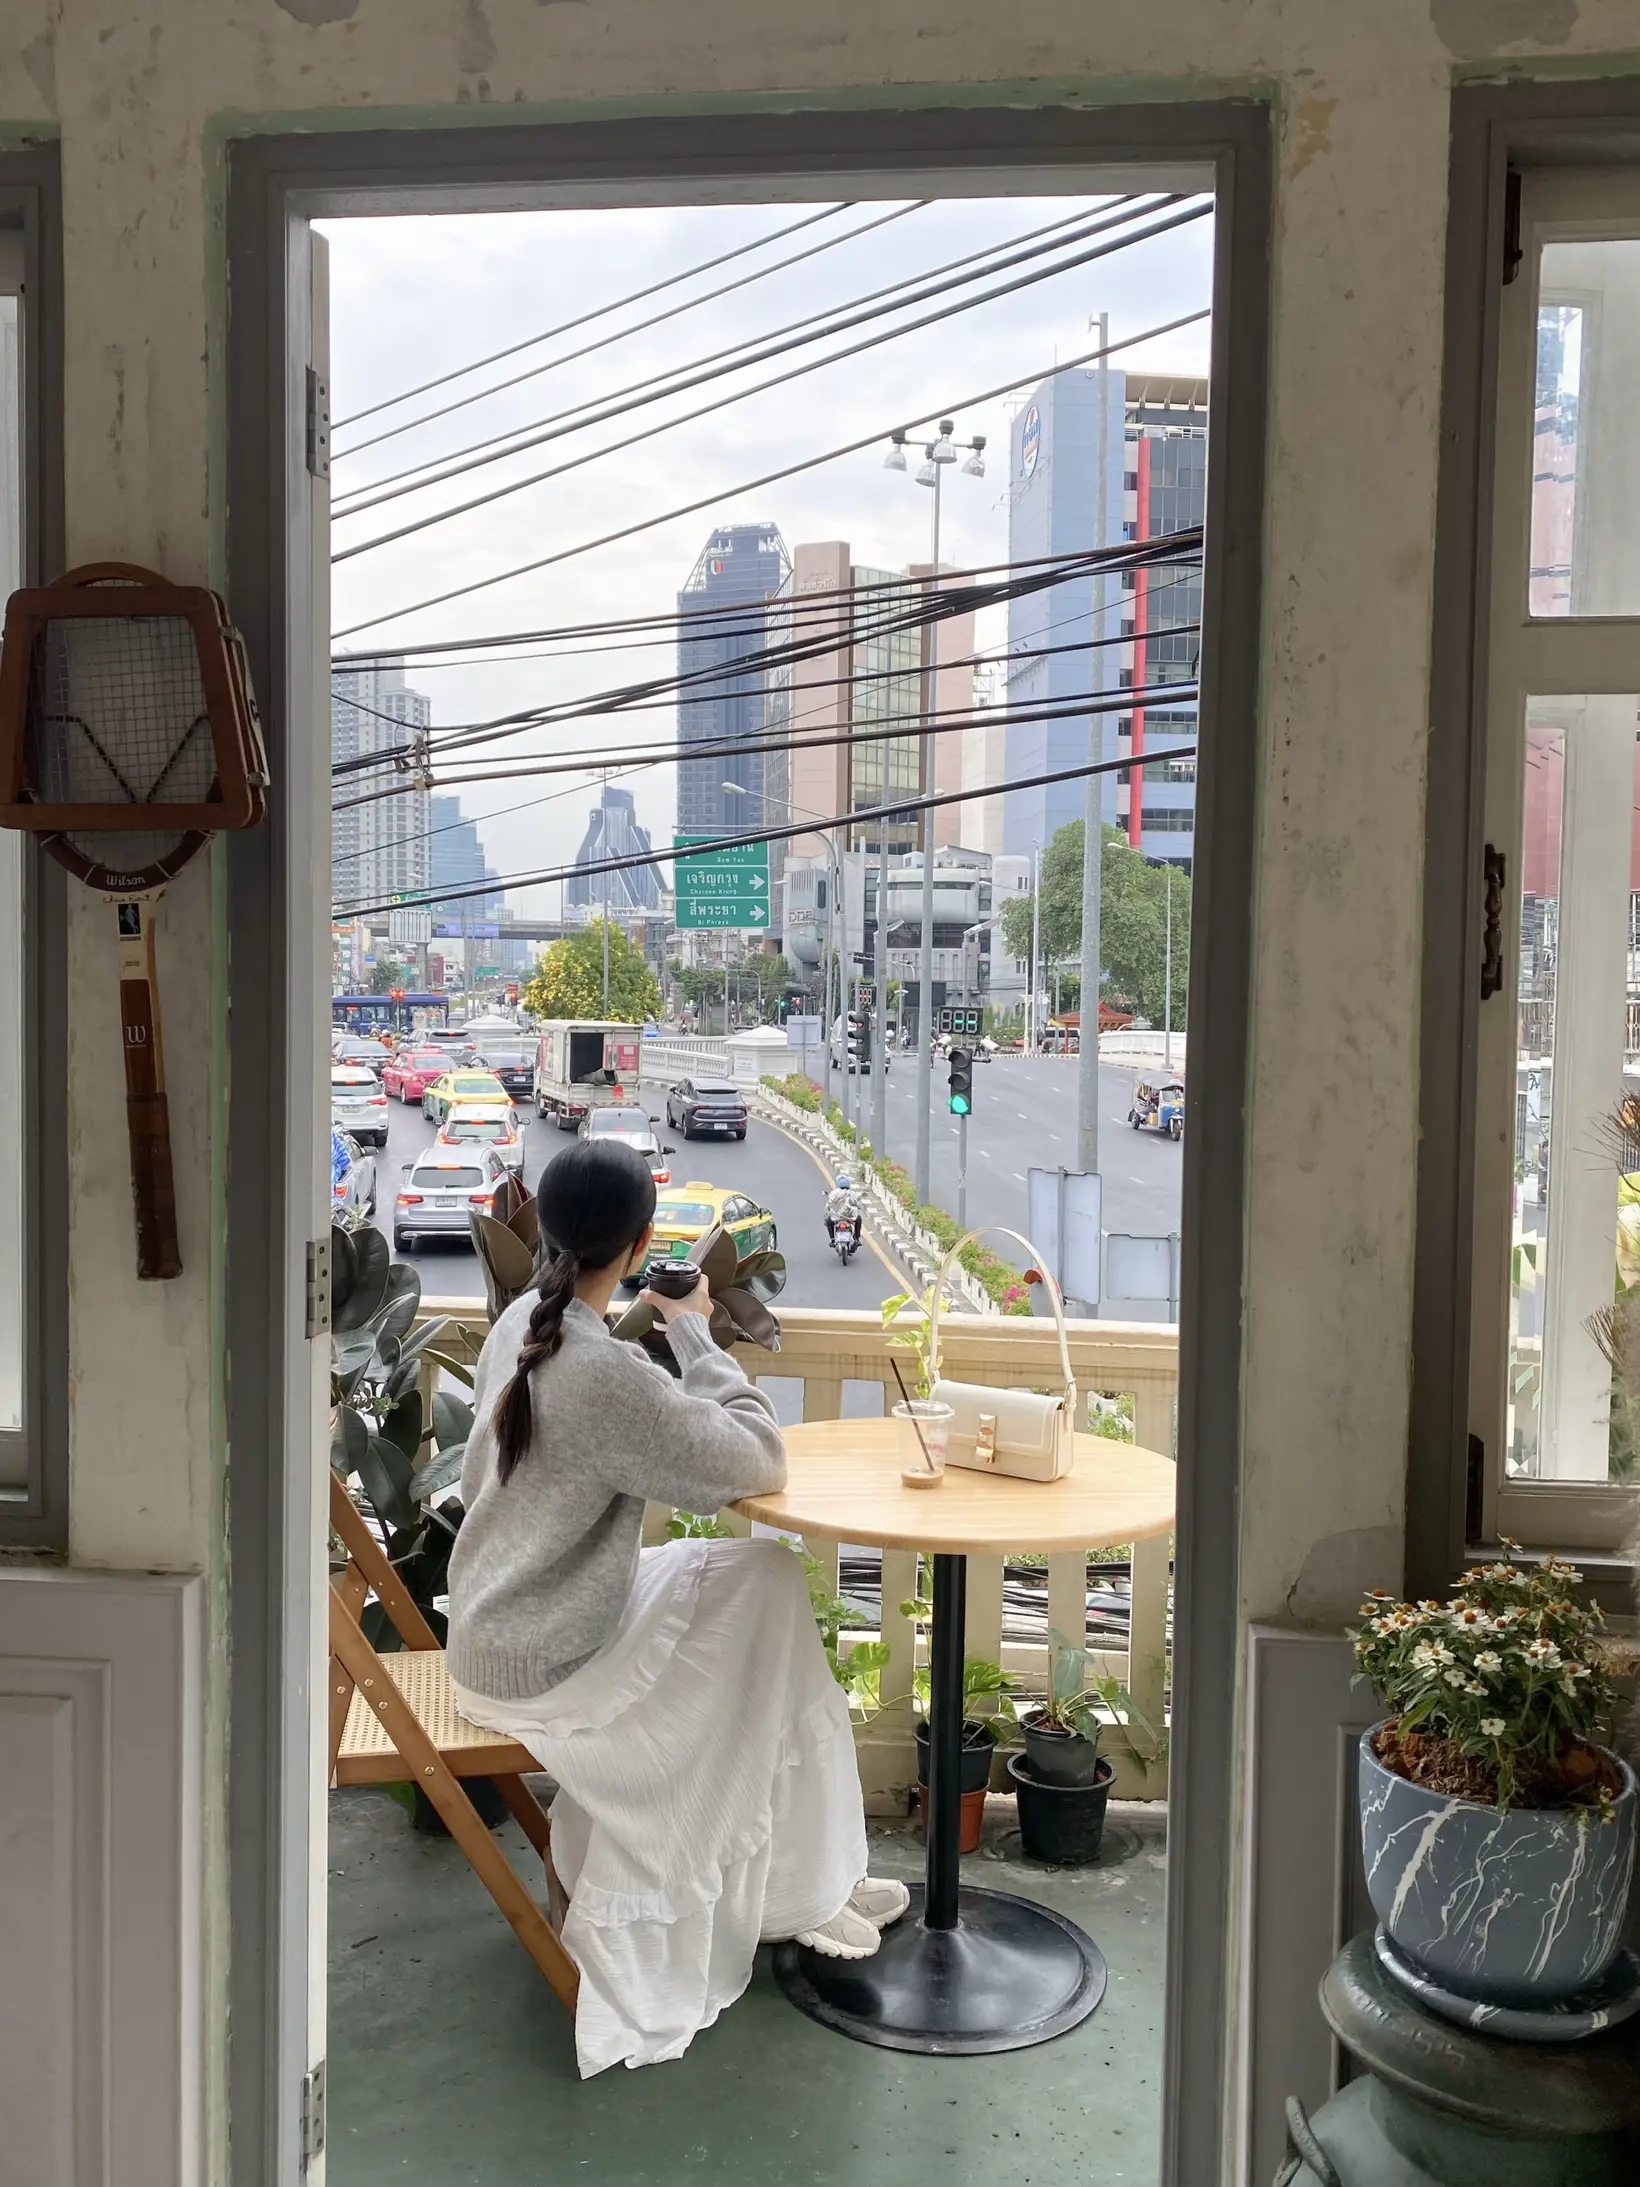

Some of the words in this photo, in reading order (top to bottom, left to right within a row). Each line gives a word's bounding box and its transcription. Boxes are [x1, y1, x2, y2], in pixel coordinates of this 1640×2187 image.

[106, 874, 146, 886] Wilson
[687, 870, 739, 888] เจริญกรุง
[689, 897, 737, 916] สี่พระยา
[126, 1025, 146, 1043] W
